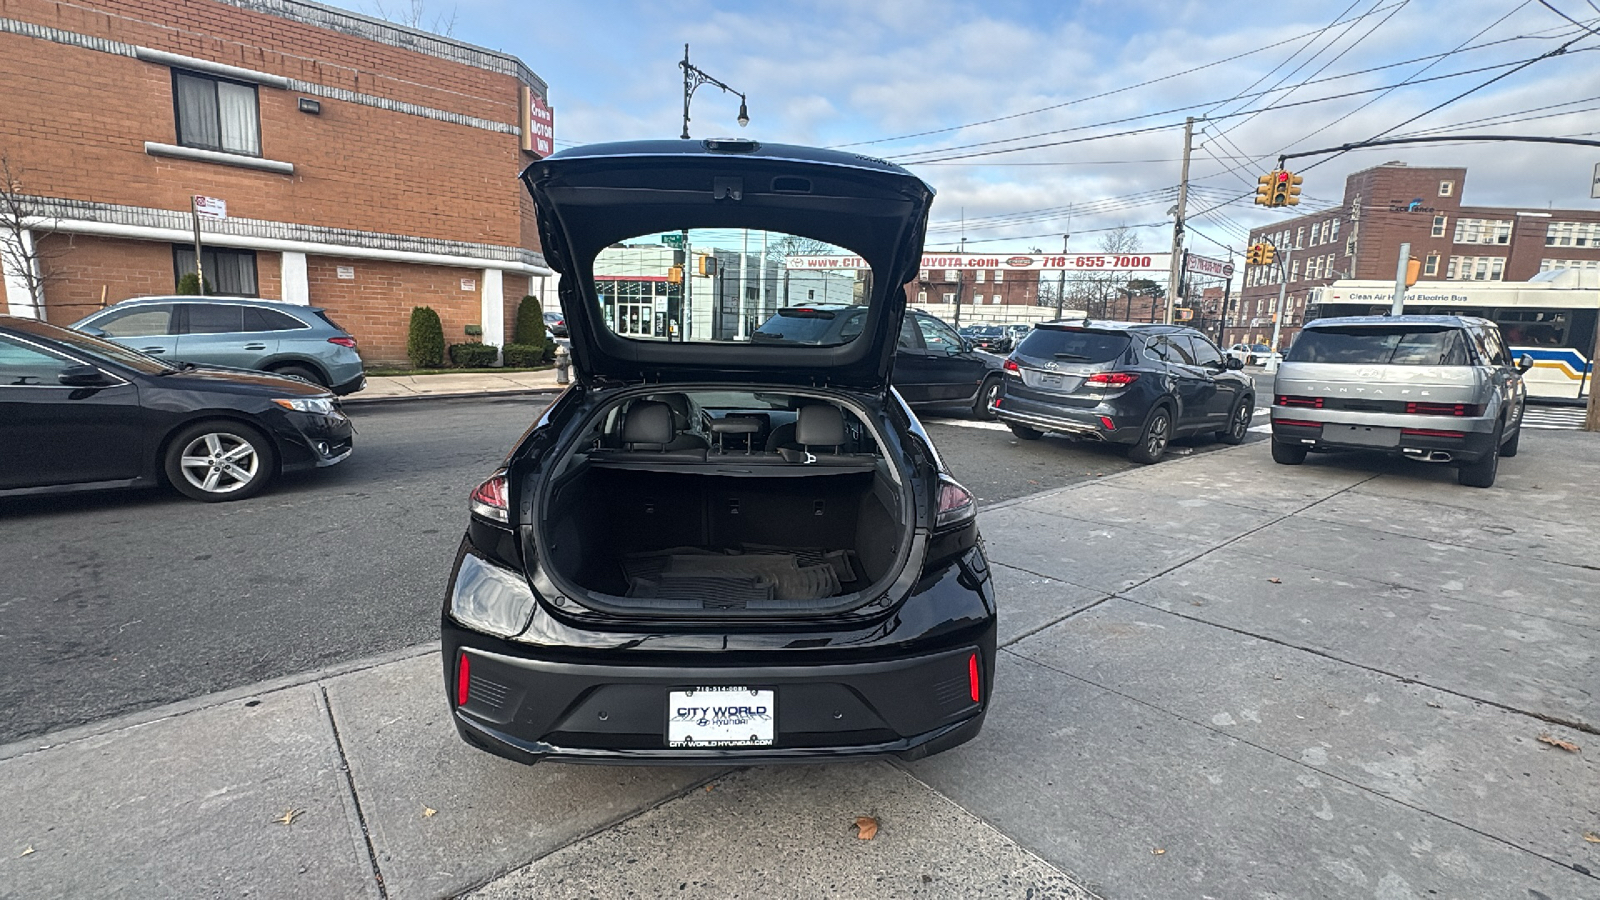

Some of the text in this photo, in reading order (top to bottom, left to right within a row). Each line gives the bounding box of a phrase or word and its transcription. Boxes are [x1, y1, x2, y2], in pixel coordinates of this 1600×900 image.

[531, 102, 551, 121] Crown
[531, 120, 552, 139] MOTOR
[1374, 293, 1386, 301] Air
[1417, 294, 1449, 302] Electric
[1451, 294, 1468, 302] Bus
[1307, 386, 1383, 395] SANTA
[677, 706, 767, 717] CITY WORLD
